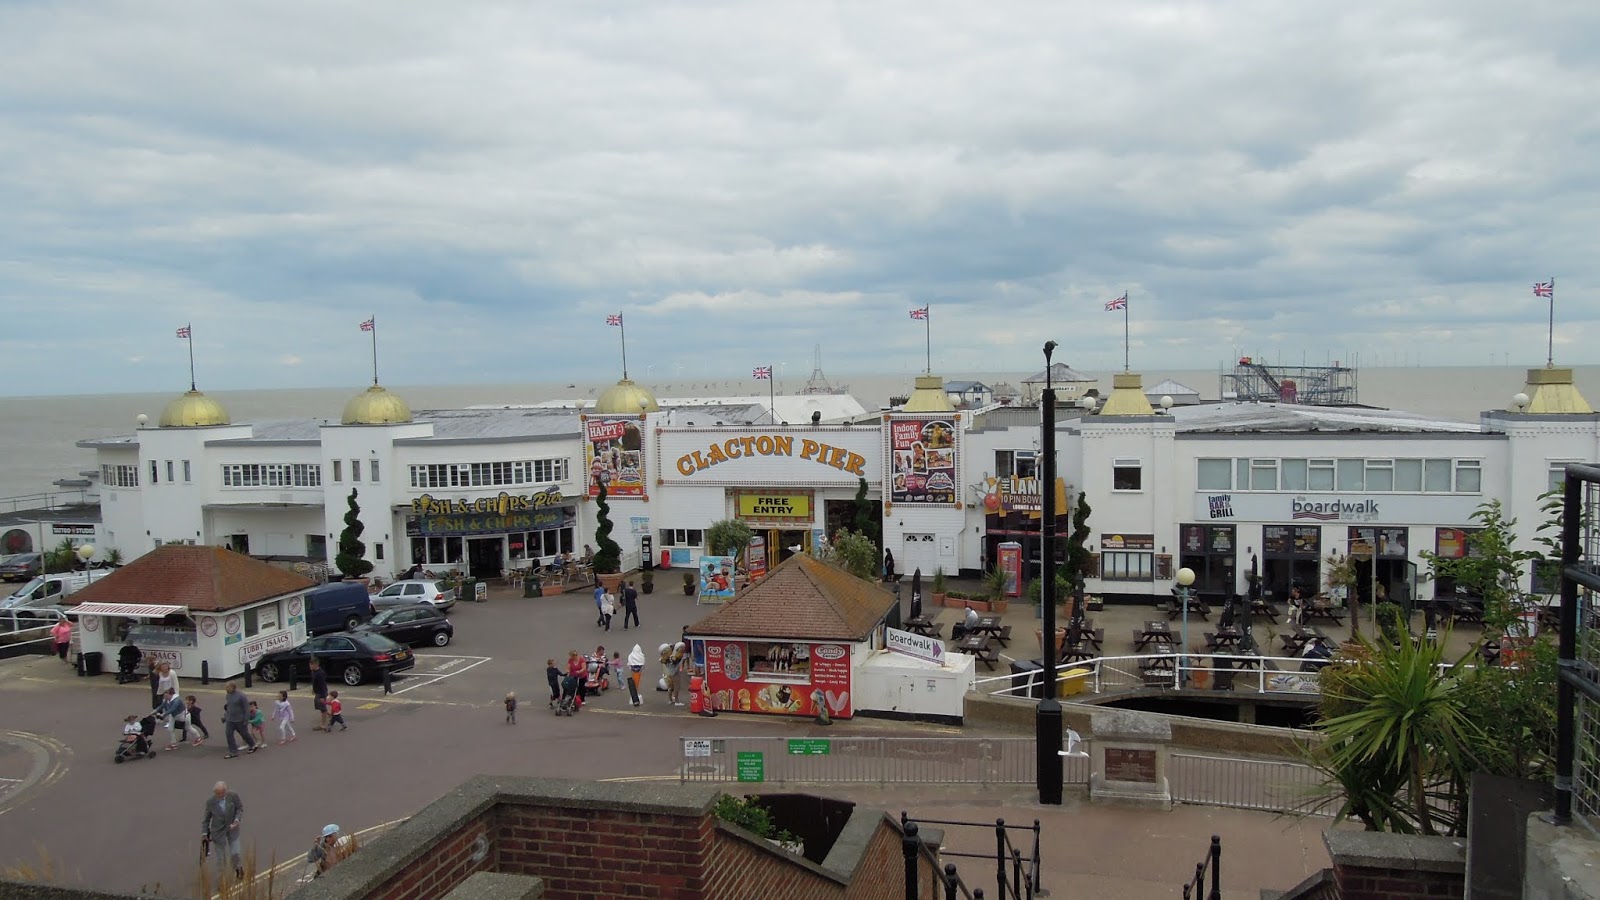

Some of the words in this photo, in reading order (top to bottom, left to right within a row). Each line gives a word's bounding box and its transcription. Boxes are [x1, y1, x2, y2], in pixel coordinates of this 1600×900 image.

[589, 424, 617, 437] HAPPY
[893, 424, 918, 432] Indoor
[894, 431, 919, 440] Family
[895, 440, 910, 448] Fun
[676, 435, 794, 477] CLACTON
[800, 438, 866, 477] PIER
[1001, 478, 1010, 494] THE
[758, 497, 790, 506] FREE
[1009, 495, 1021, 503] PIN
[1208, 494, 1231, 502] family
[457, 498, 470, 514] &
[475, 492, 529, 516] CHIPS
[1209, 501, 1224, 510] BAR
[1292, 498, 1379, 513] boardwalk
[753, 506, 794, 514] ENTRY
[1210, 508, 1234, 519] GRILL
[469, 518, 481, 530] &
[243, 642, 263, 654] TUBBY
[266, 635, 289, 647] ISAACS
[889, 631, 931, 651] boardwalk
[817, 646, 843, 656] Candy
